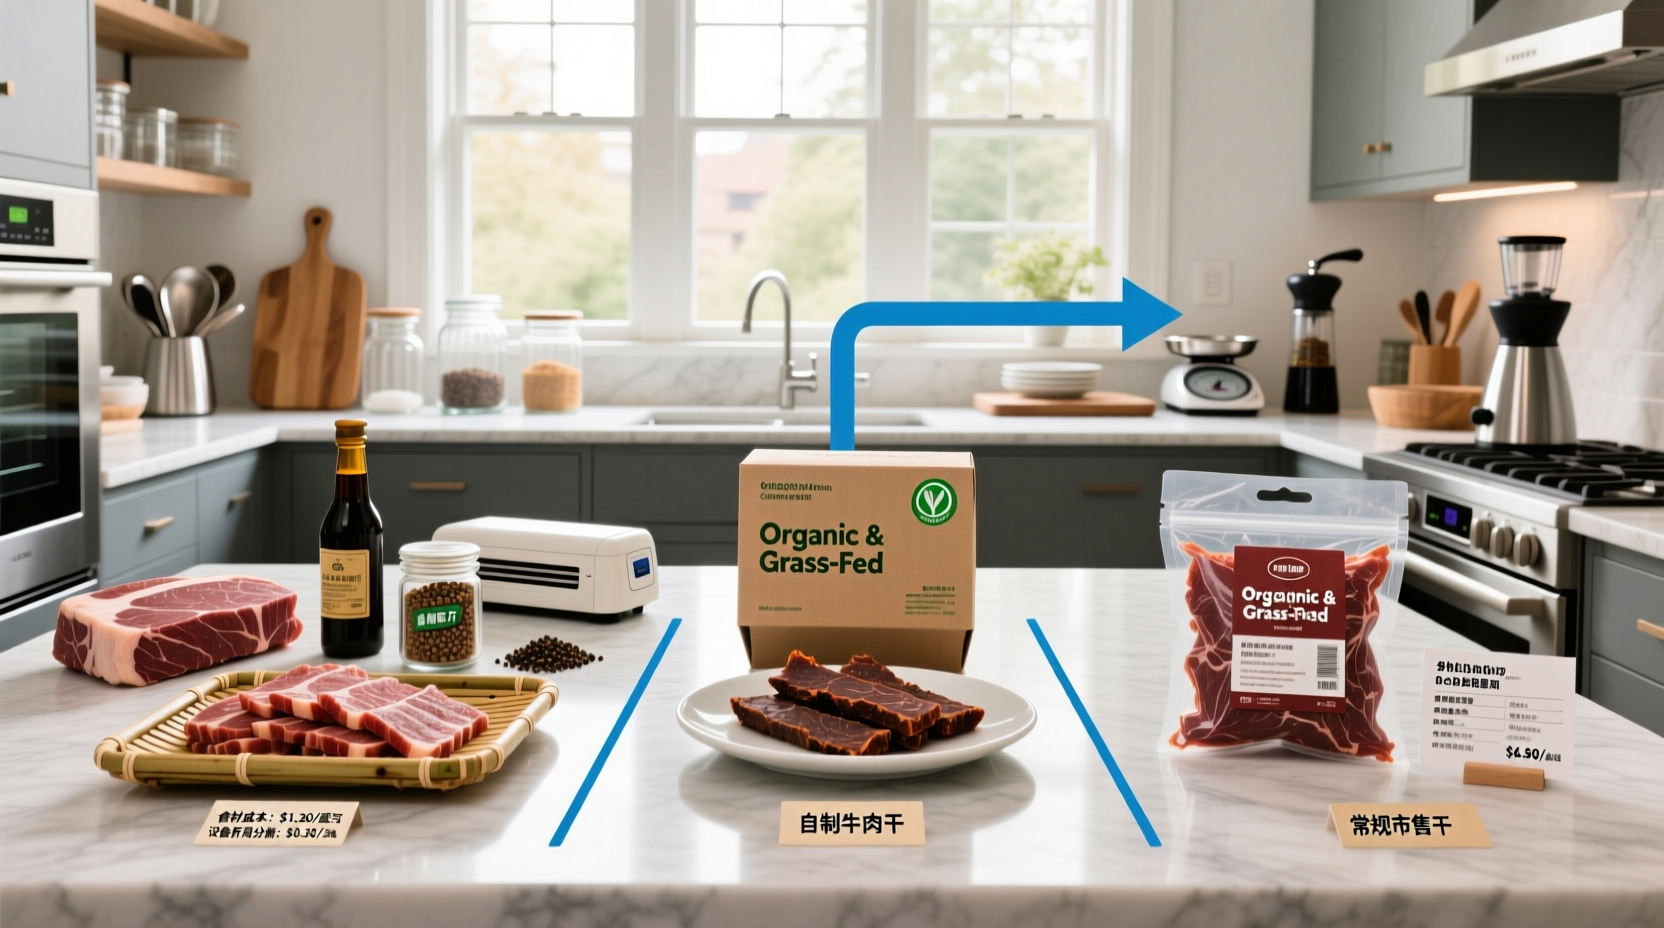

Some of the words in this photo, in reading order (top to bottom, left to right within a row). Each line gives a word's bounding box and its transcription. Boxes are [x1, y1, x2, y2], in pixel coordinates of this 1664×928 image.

[759, 522, 859, 551] Organic
[865, 524, 884, 546] &
[759, 550, 884, 574] Grass-Fed
[1323, 590, 1336, 605] &
[801, 811, 904, 834] 自制牛肉干
[1349, 813, 1452, 836] 常规市售干
